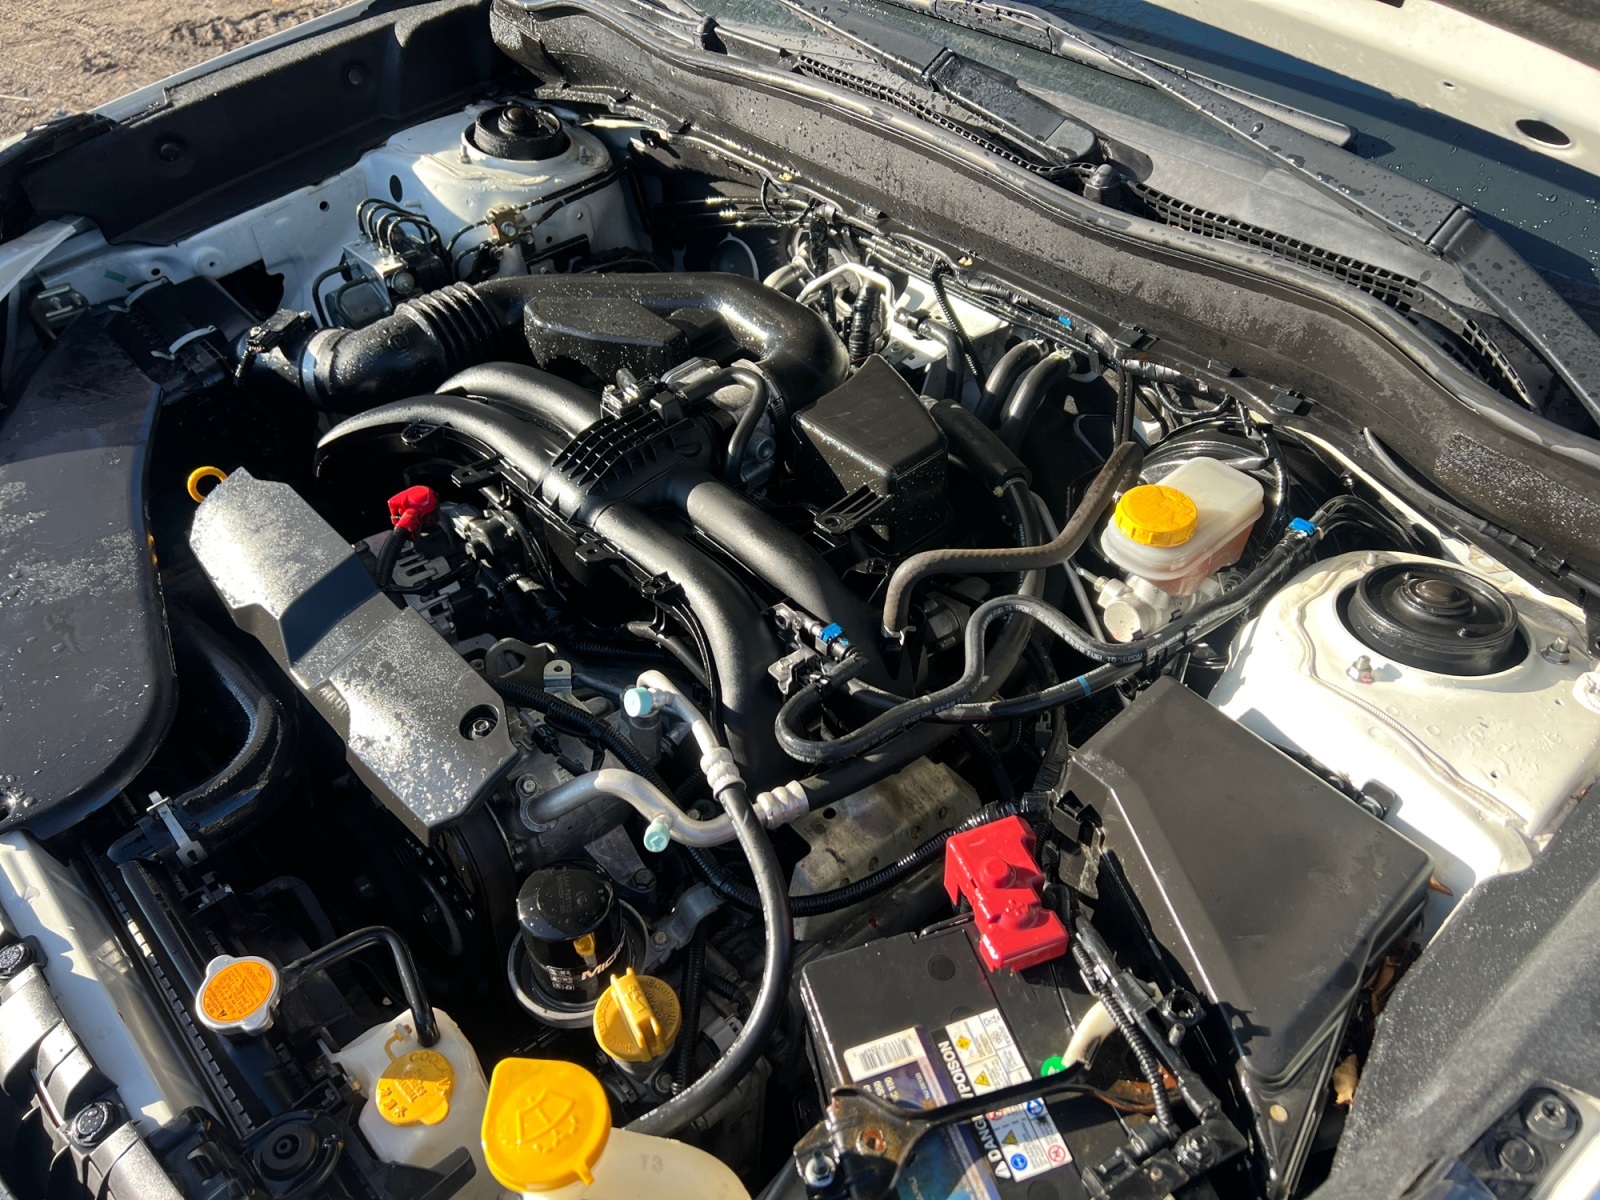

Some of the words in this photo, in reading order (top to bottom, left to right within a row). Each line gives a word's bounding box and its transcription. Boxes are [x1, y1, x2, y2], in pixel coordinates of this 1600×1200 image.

[647, 978, 675, 1006] ENGINE
[667, 1009, 677, 1026] OIL
[639, 1152, 663, 1173] T3
